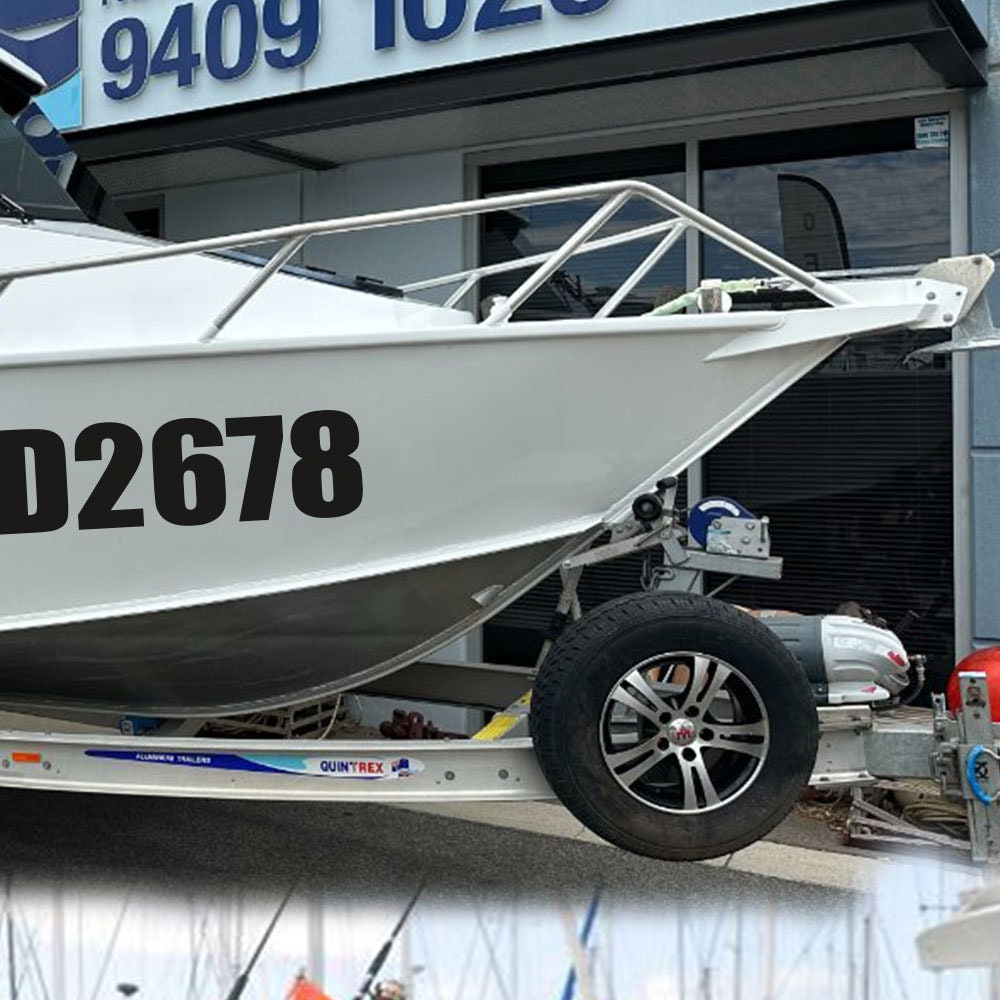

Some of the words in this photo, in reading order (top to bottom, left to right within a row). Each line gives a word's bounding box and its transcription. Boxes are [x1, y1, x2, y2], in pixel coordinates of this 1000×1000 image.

[101, 0, 322, 100] 9409
[372, 0, 608, 51] 10
[177, 754, 212, 764] TRAILERS
[320, 760, 384, 774] QUINTREX
